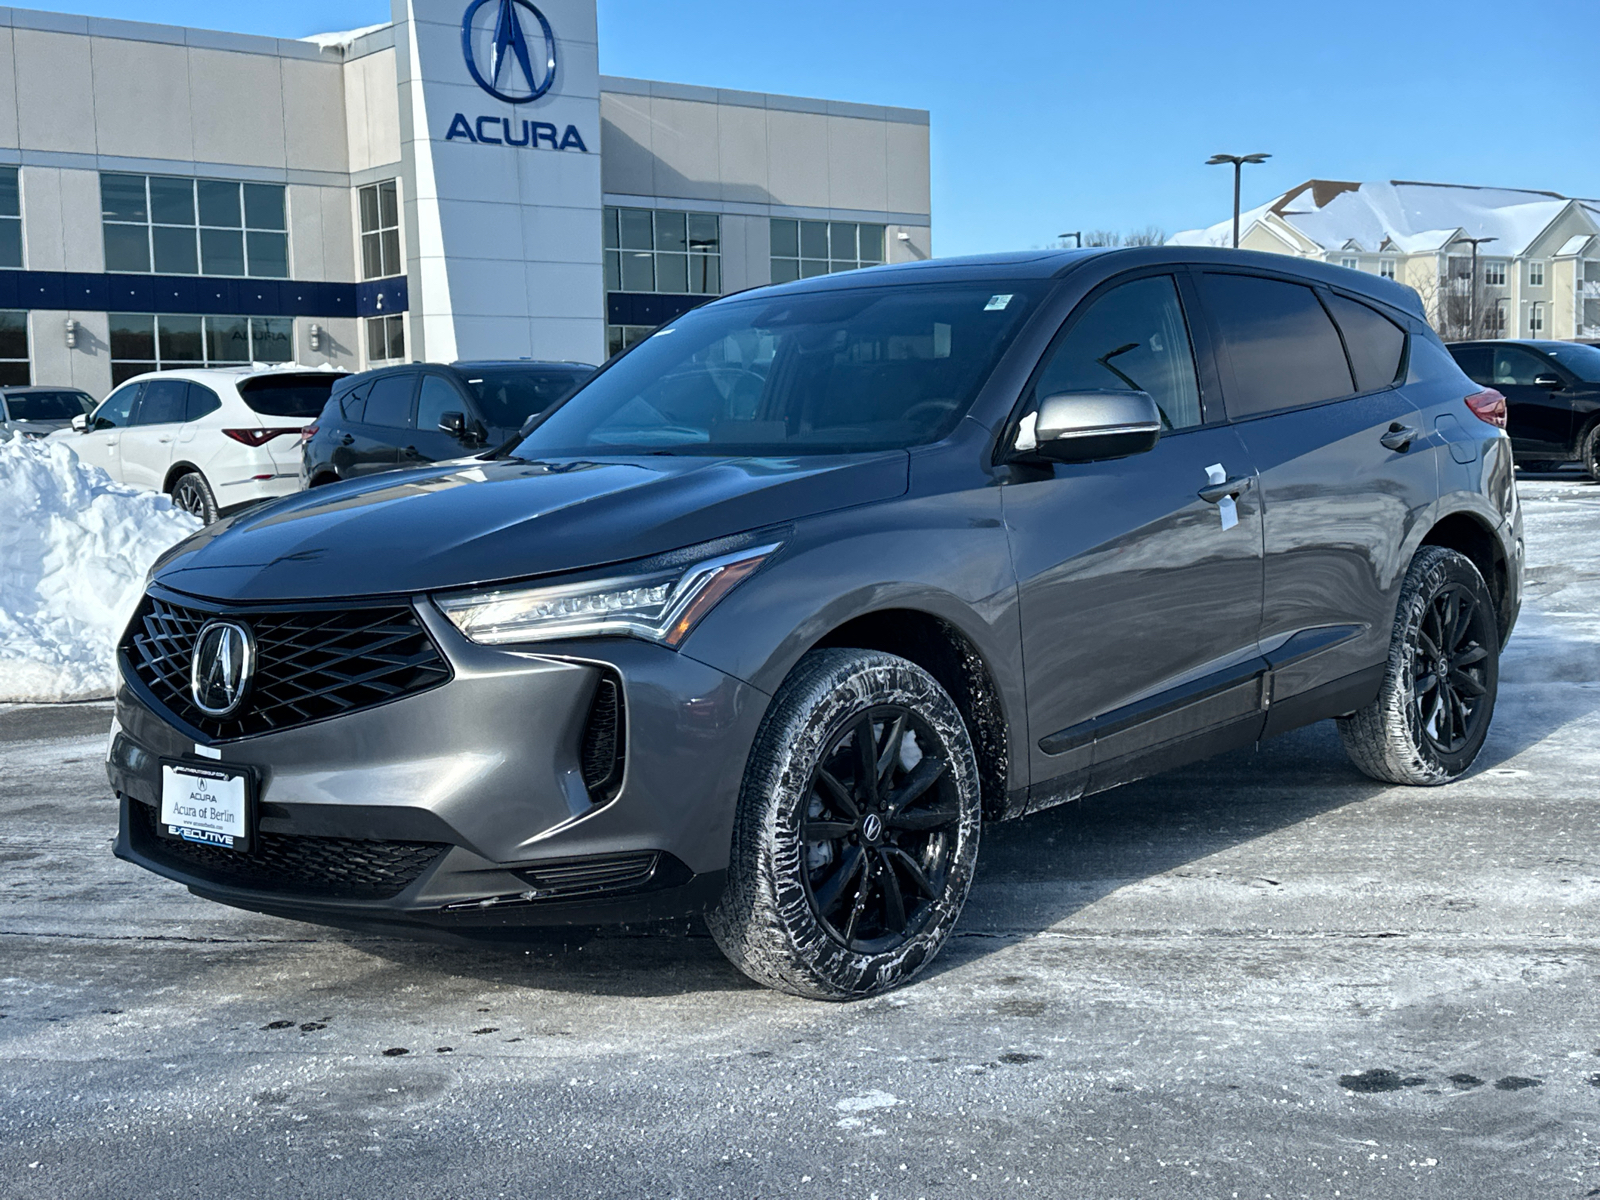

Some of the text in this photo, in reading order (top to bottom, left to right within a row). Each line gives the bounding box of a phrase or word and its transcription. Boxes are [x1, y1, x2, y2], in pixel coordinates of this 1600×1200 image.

[445, 112, 588, 152] ACURA
[190, 792, 217, 803] ACURA
[173, 802, 235, 823] Acura of Berlin
[168, 825, 234, 845] EXECUTIVE
